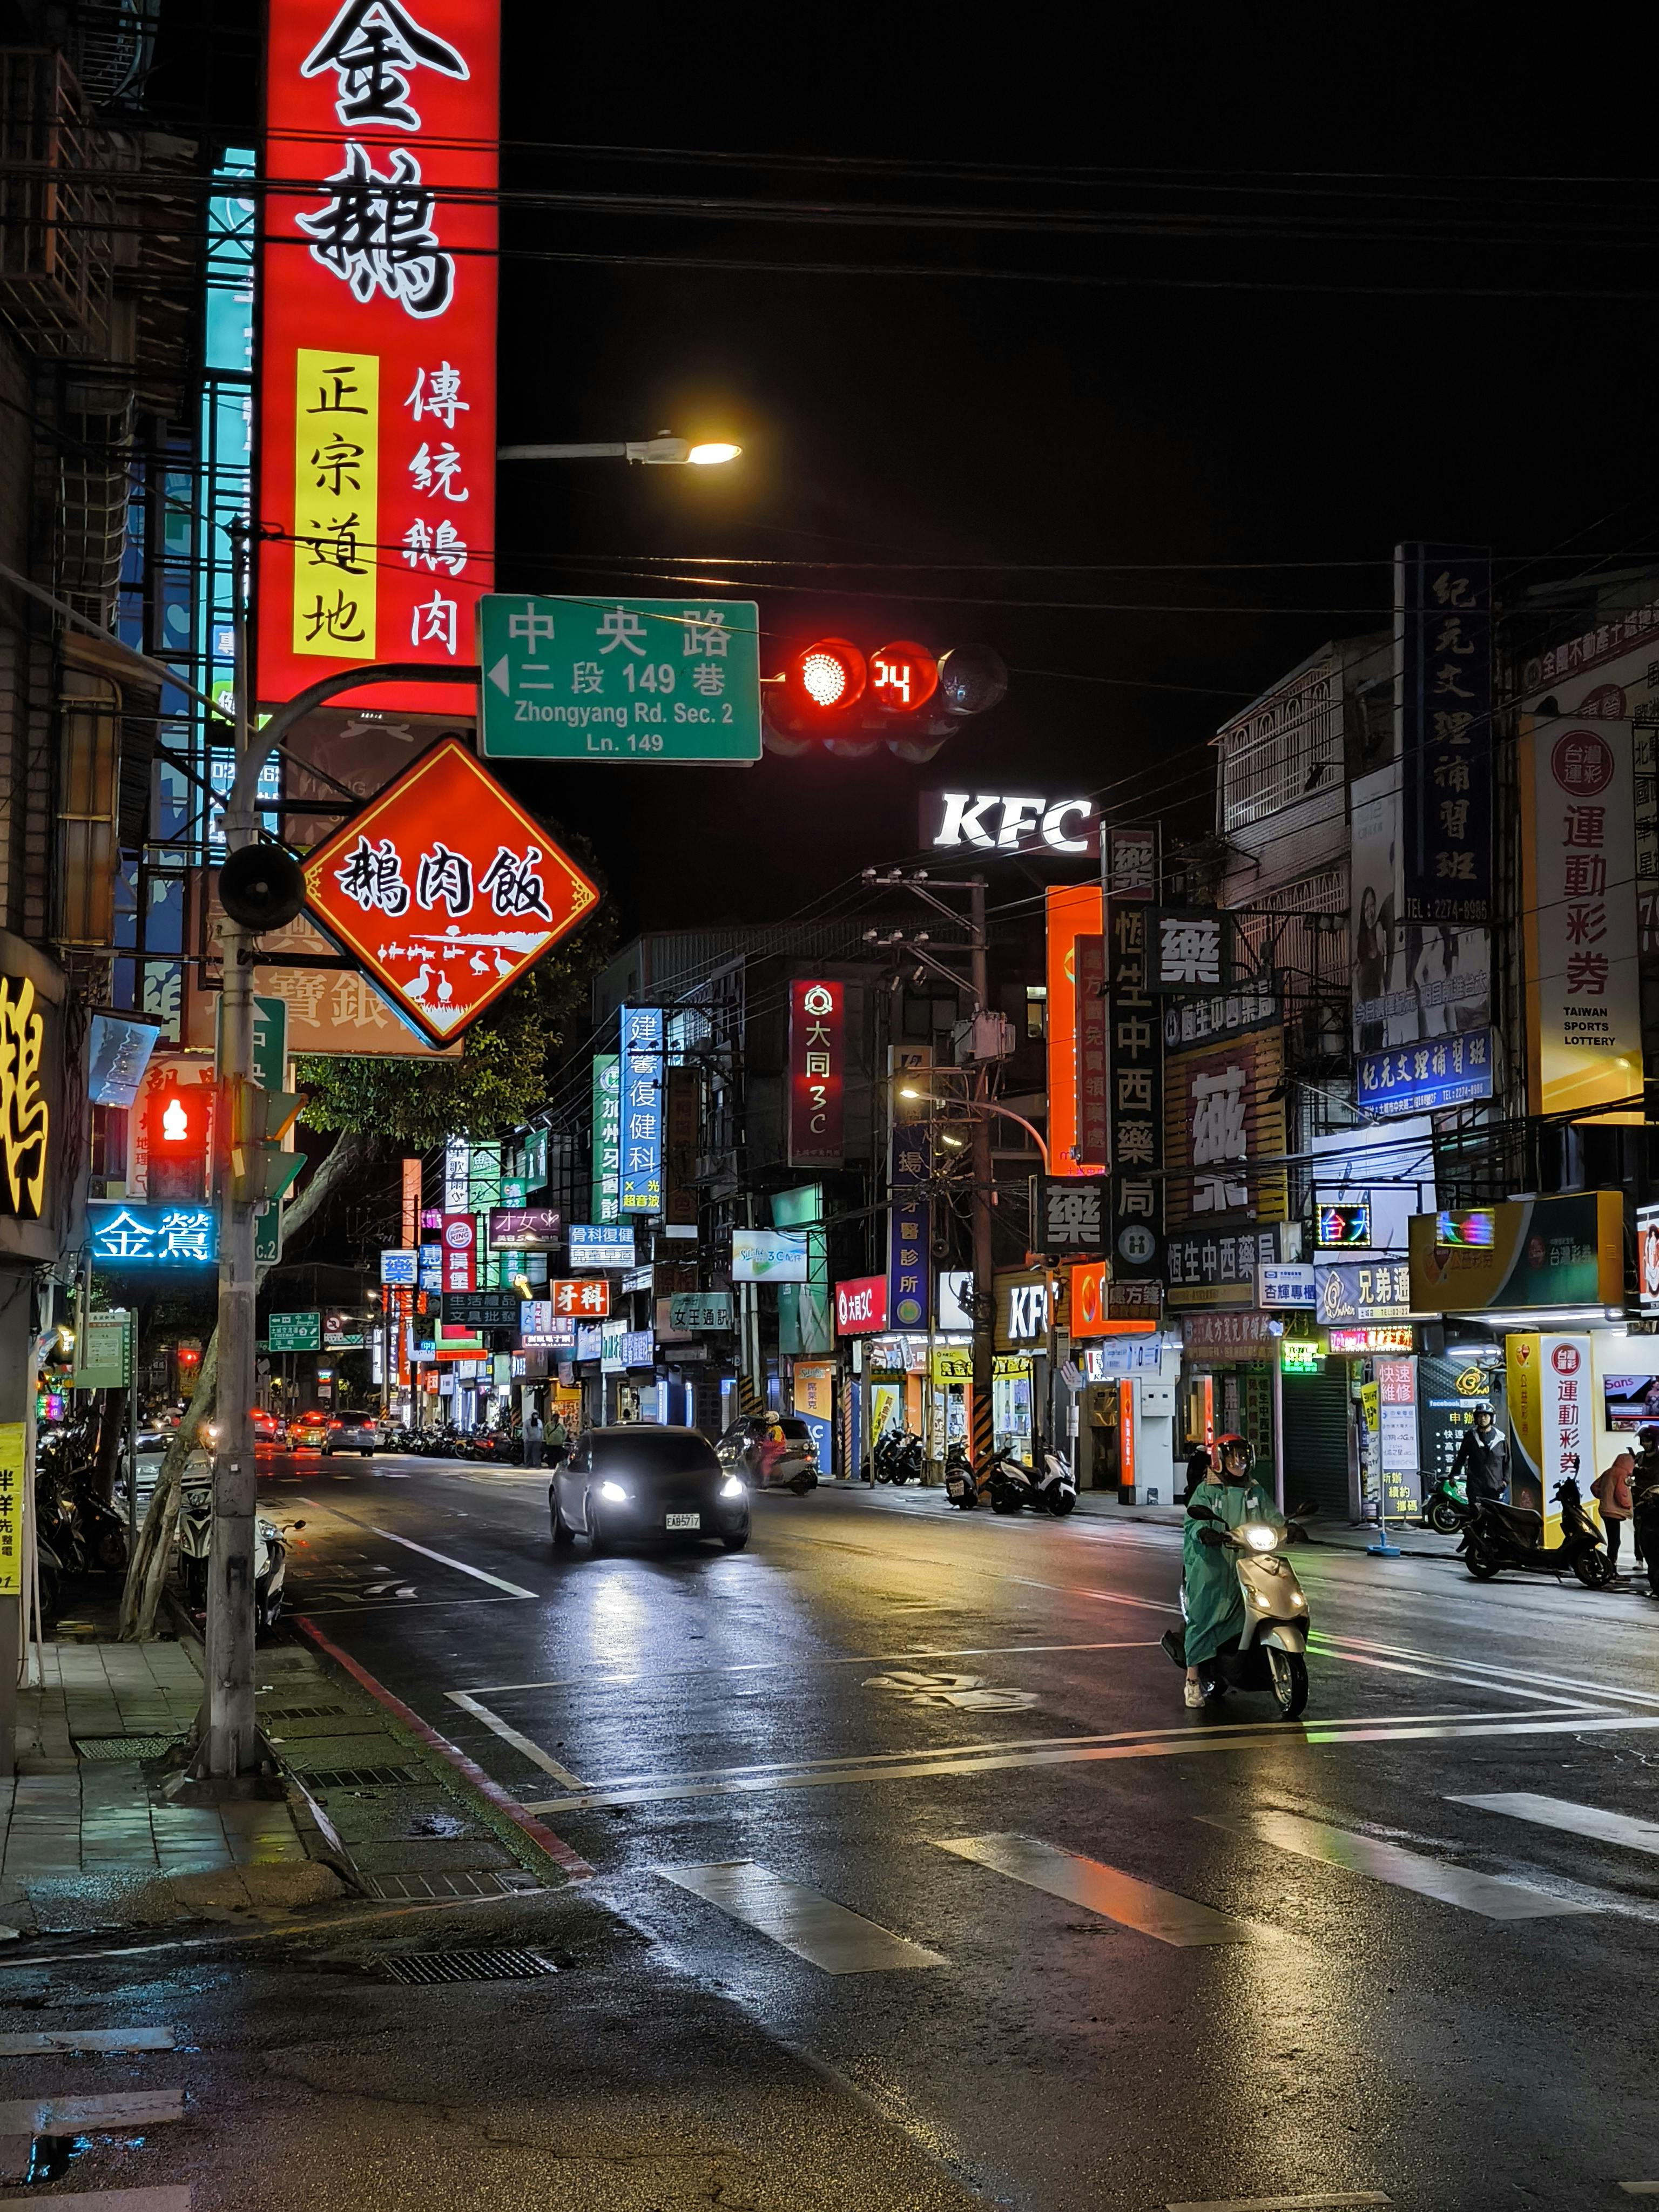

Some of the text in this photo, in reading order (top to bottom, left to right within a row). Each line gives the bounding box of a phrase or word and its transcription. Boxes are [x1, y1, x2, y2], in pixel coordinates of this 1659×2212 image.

[302, 366, 369, 643] 正宗道地
[403, 360, 470, 655] 傳統鵝肉
[508, 604, 731, 657] 中央路
[515, 702, 733, 728] Zhongyang Rd. Sec. 2
[586, 733, 664, 752] Ln. 149
[933, 793, 1092, 852] KFC
[1114, 840, 1154, 887] 藥
[334, 835, 553, 922] 鵝肉飯
[1562, 805, 1609, 995] 運動彩券
[1159, 919, 1220, 983] 藥
[1563, 1007, 1608, 1017] TAIWAN
[1564, 1021, 1609, 1032] SPORTS
[1564, 1036, 1616, 1047] LOTTERY
[805, 1021, 831, 1134] 大同3C
[1192, 1065, 1248, 1213] 藥
[648, 1180, 660, 1192] 光
[623, 1194, 660, 1208] 超音波
[1047, 1185, 1102, 1243] 藥
[495, 1212, 537, 1232] 才女
[449, 1232, 469, 1242] KING
[572, 1228, 634, 1243] 骨科復健
[256, 1240, 276, 1259] c.2
[385, 1256, 413, 1282] 藥
[1264, 1284, 1316, 1300] 杏輝專櫃
[1358, 1266, 1410, 1304] 兄弟通
[557, 1284, 606, 1313] 牙科
[848, 1289, 872, 1321] 大同3C
[675, 1309, 729, 1326] 女王通訊
[1379, 1365, 1412, 1384] 快速
[1605, 1378, 1634, 1390] Sans
[1381, 1384, 1412, 1402] 維修
[1444, 1429, 1464, 1439] 快速
[1557, 1379, 1581, 1474] 運動彩券
